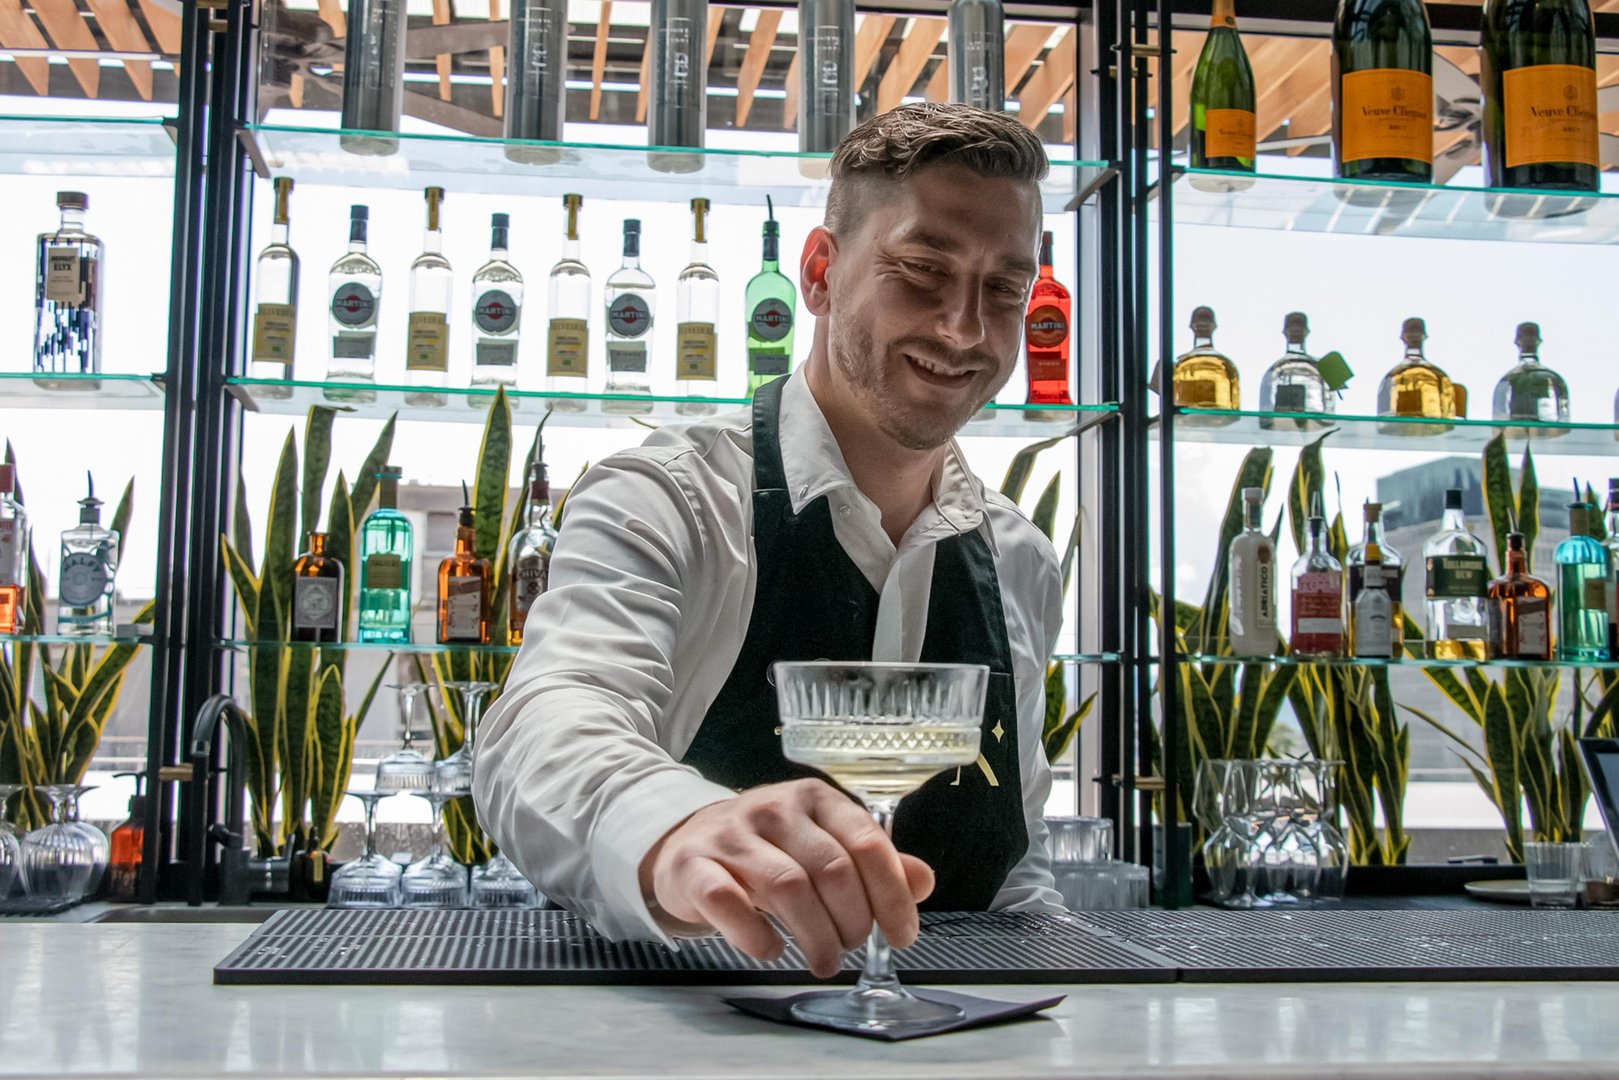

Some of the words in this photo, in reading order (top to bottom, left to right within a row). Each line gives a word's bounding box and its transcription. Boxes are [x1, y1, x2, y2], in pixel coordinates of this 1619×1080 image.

[1362, 106, 1391, 117] Veuve
[1530, 106, 1565, 117] Veuve
[53, 263, 72, 272] ELYX
[1031, 322, 1065, 330] MARTINI
[518, 568, 547, 580] CHIVA
[1261, 565, 1269, 617] ADRIATICO
